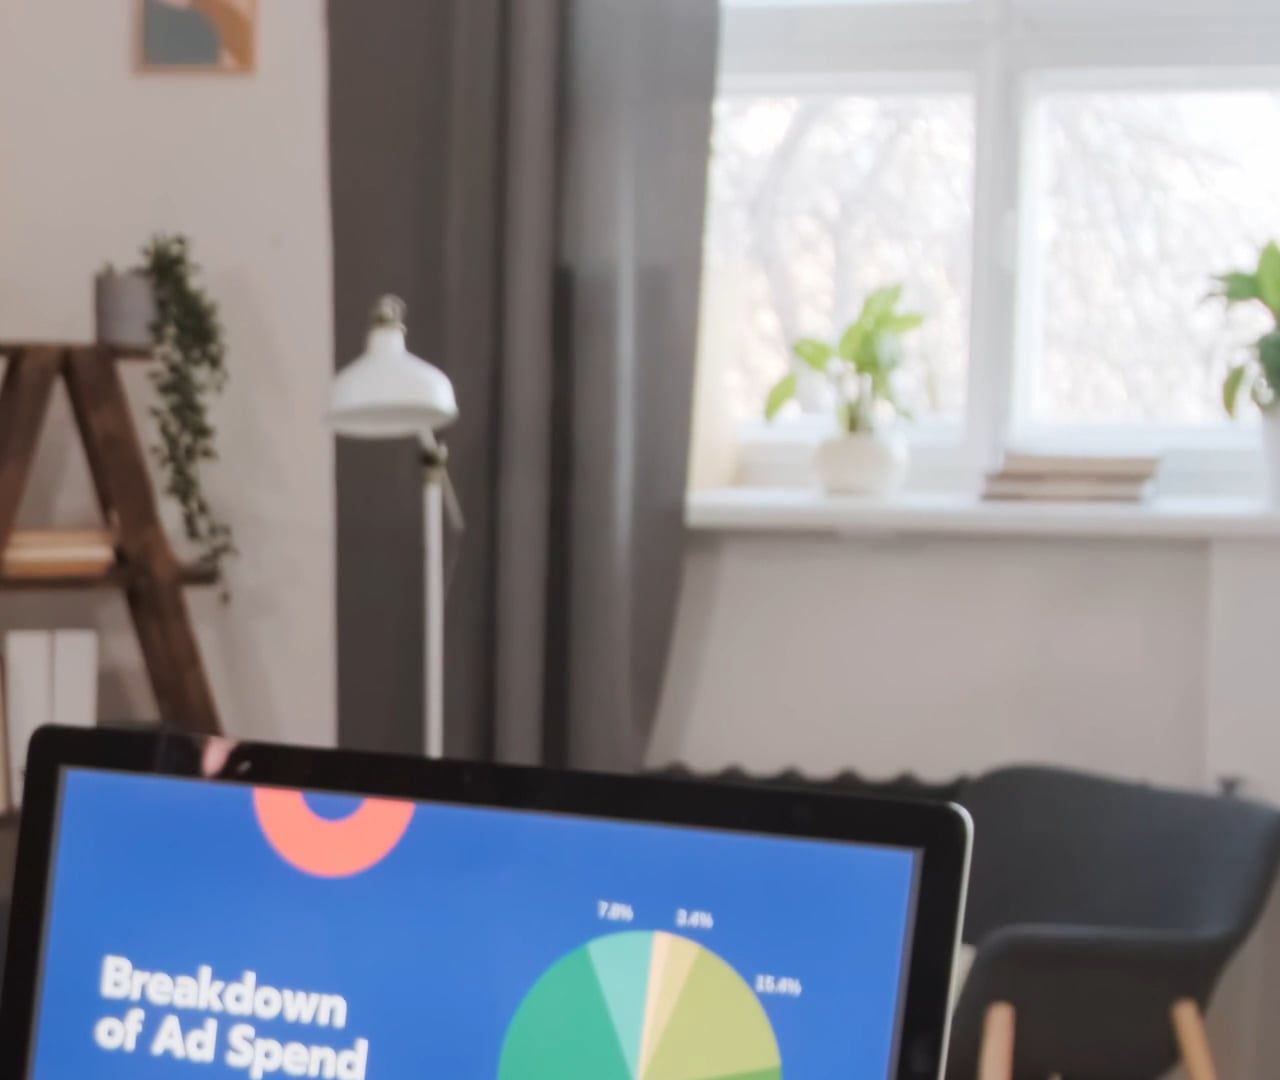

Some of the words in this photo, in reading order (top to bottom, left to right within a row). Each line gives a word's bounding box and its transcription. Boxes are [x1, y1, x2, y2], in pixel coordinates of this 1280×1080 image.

[100, 954, 348, 1029] Breakdown
[95, 1008, 145, 1053] of
[151, 1014, 218, 1063] Ad
